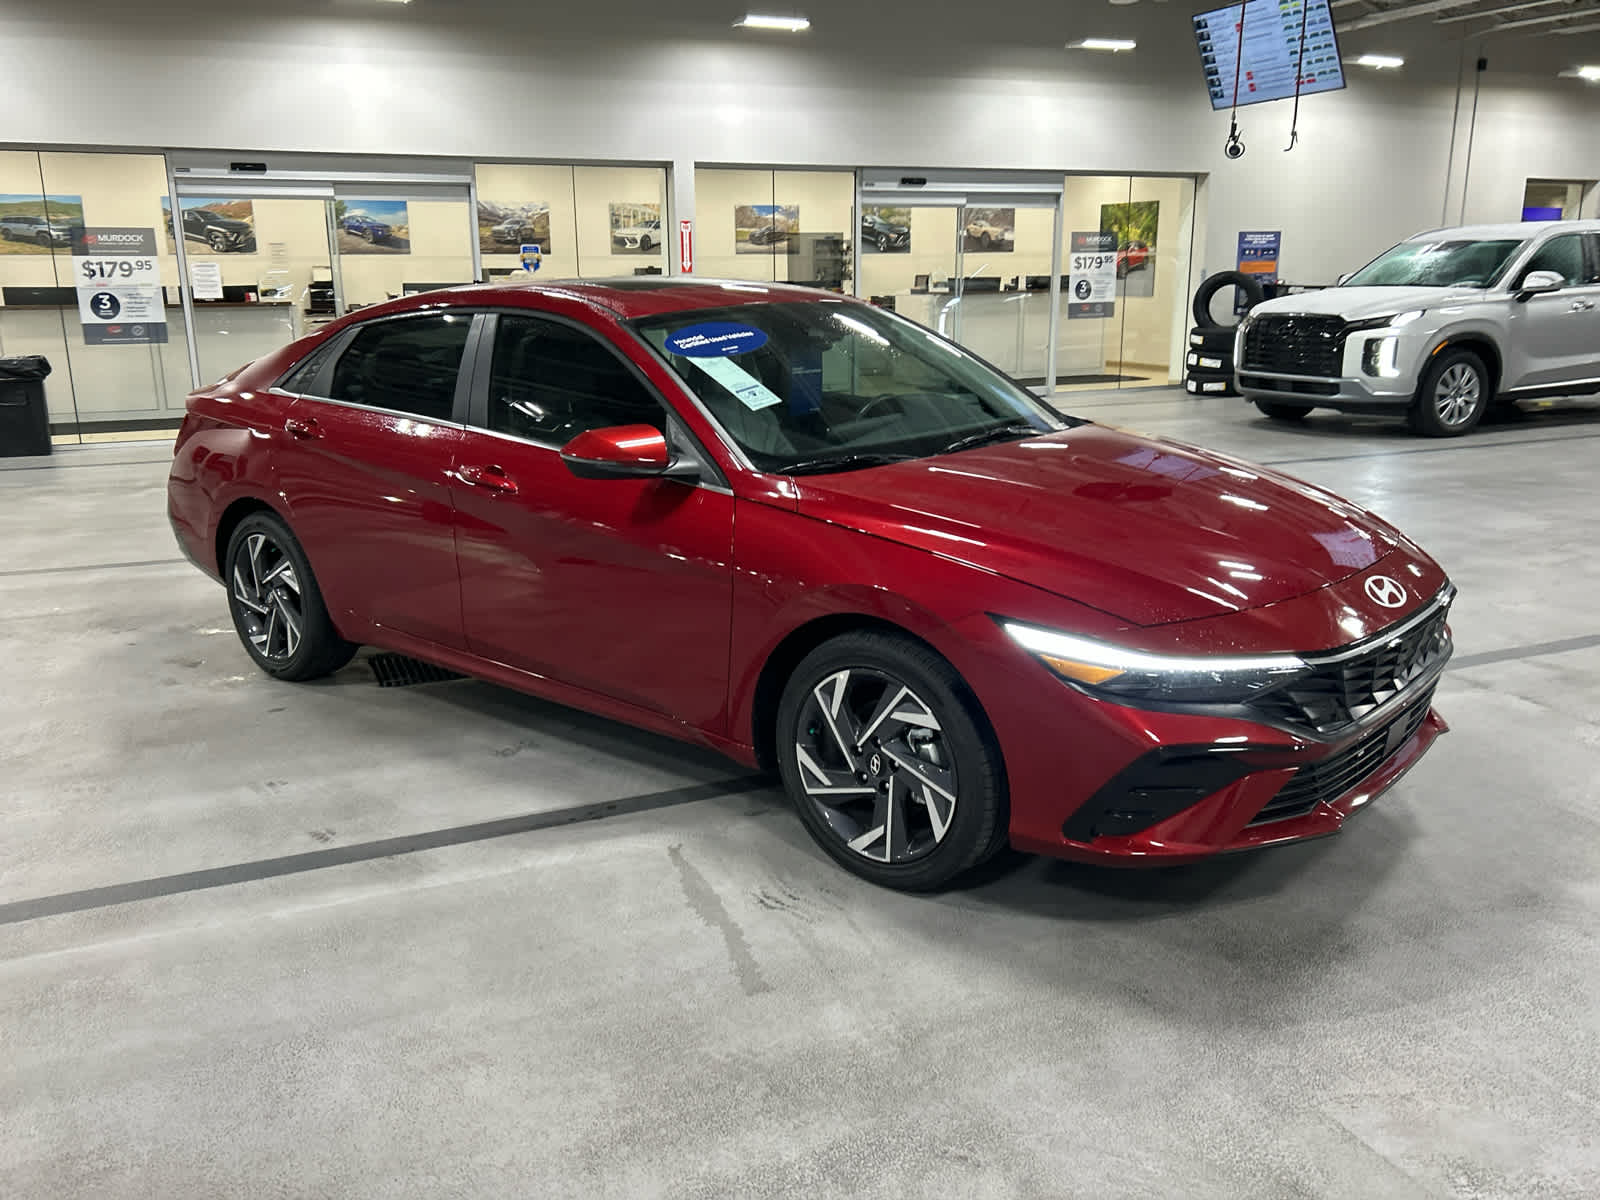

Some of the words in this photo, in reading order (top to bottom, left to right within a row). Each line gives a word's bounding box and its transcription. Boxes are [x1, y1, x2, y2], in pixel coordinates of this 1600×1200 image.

[98, 234, 144, 242] MURDOCK
[82, 260, 153, 280] $179.95
[1079, 281, 1087, 292] 3
[98, 294, 111, 309] 3
